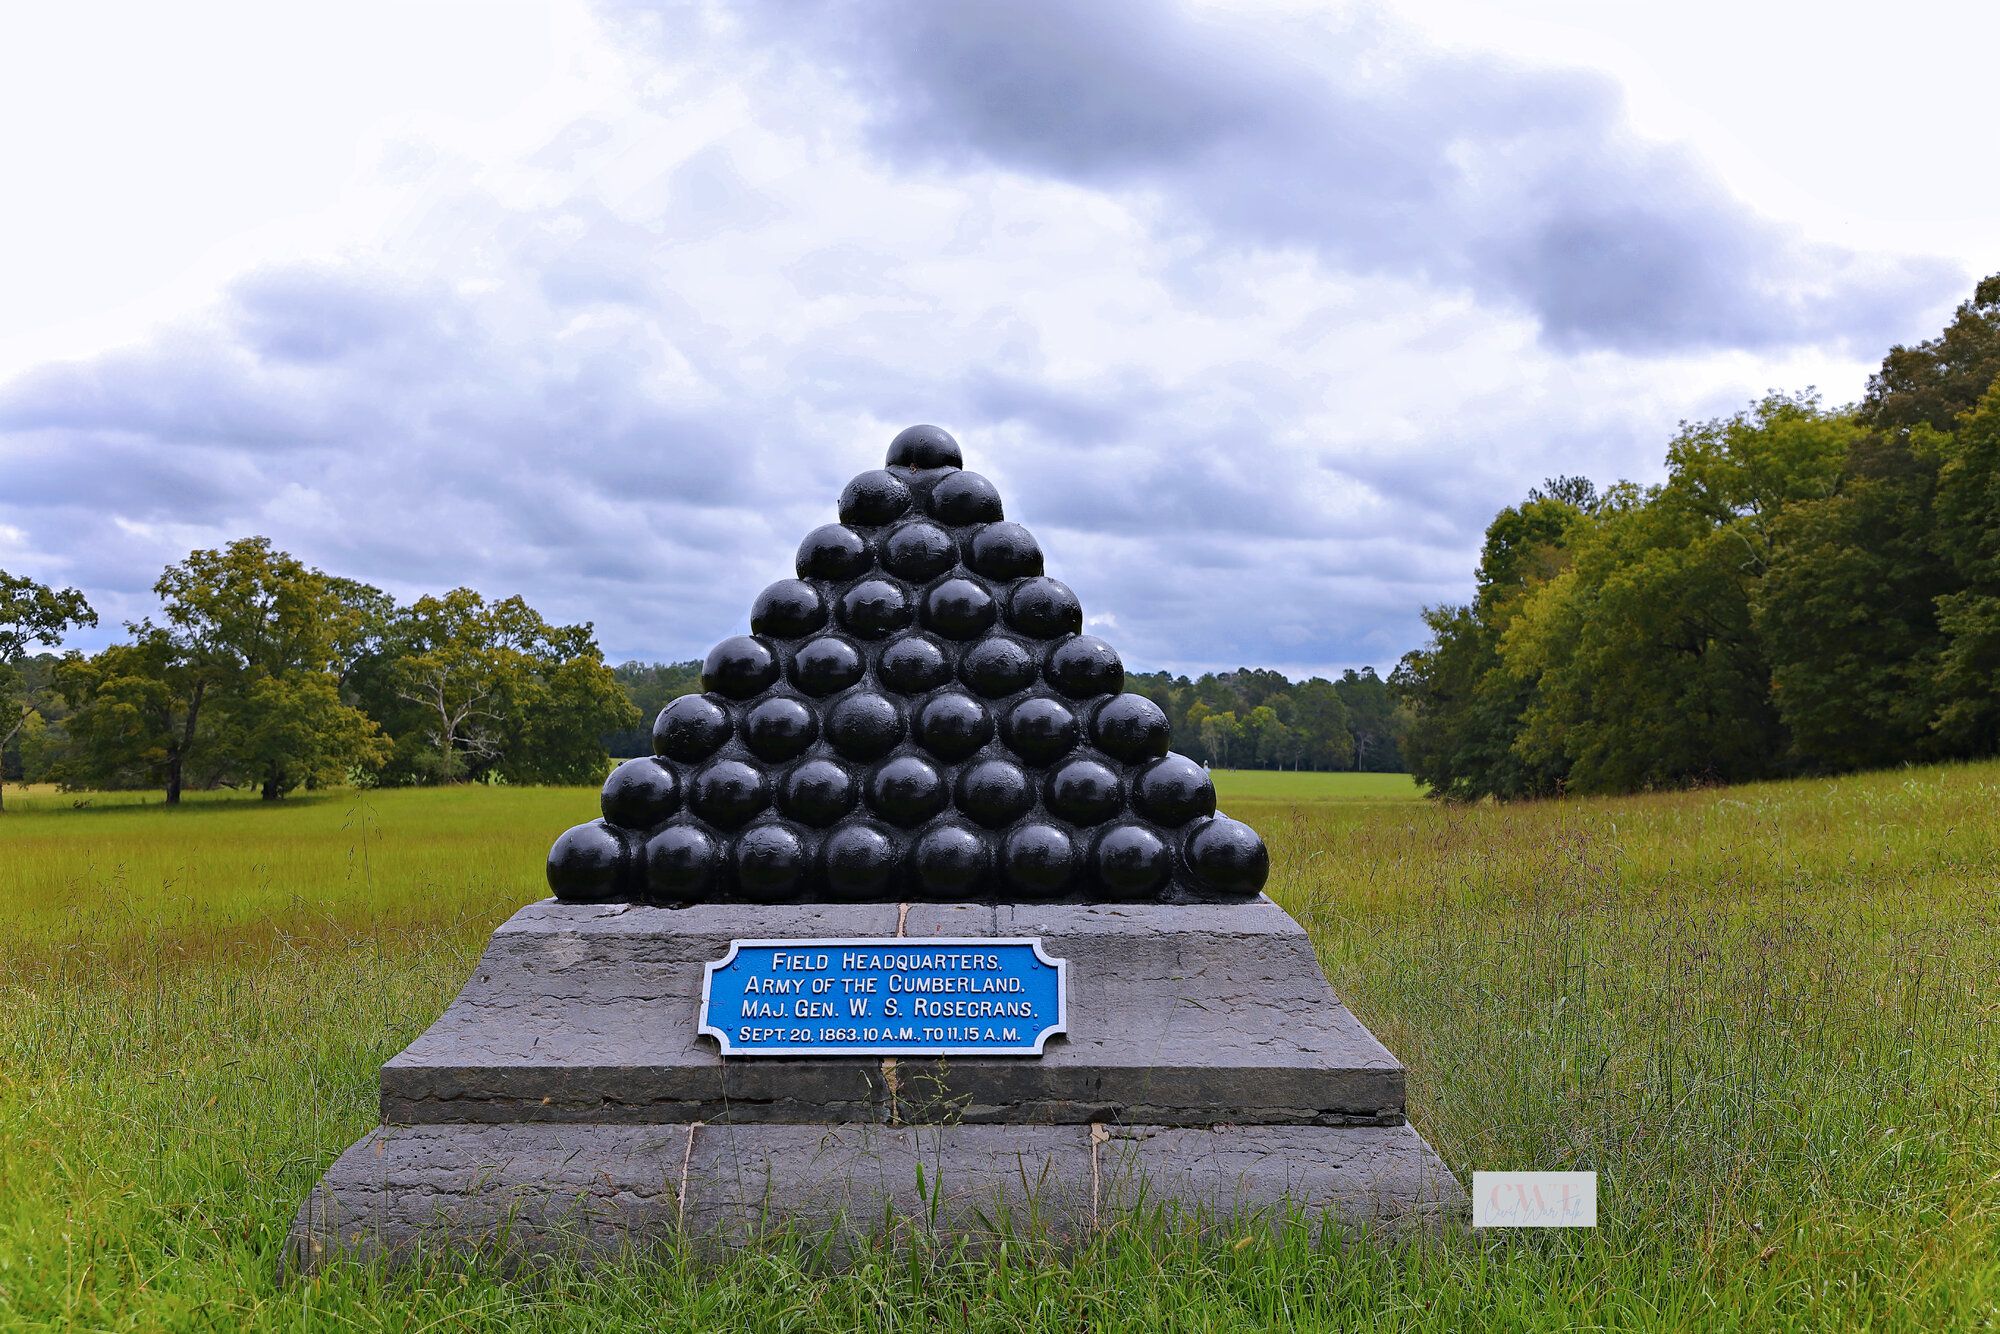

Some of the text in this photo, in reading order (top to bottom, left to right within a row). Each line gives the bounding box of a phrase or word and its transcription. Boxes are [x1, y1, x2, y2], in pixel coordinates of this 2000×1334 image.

[772, 952, 829, 971] FIELD
[743, 975, 806, 995] ARMY
[811, 977, 835, 994] OF
[841, 977, 878, 994] THE
[741, 1000, 789, 1018] MAJ.
[794, 999, 839, 1018] GEN.
[849, 998, 873, 1017] W.
[884, 997, 903, 1017] S.
[739, 1026, 786, 1042] SEPT.
[923, 1027, 944, 1041] TO
